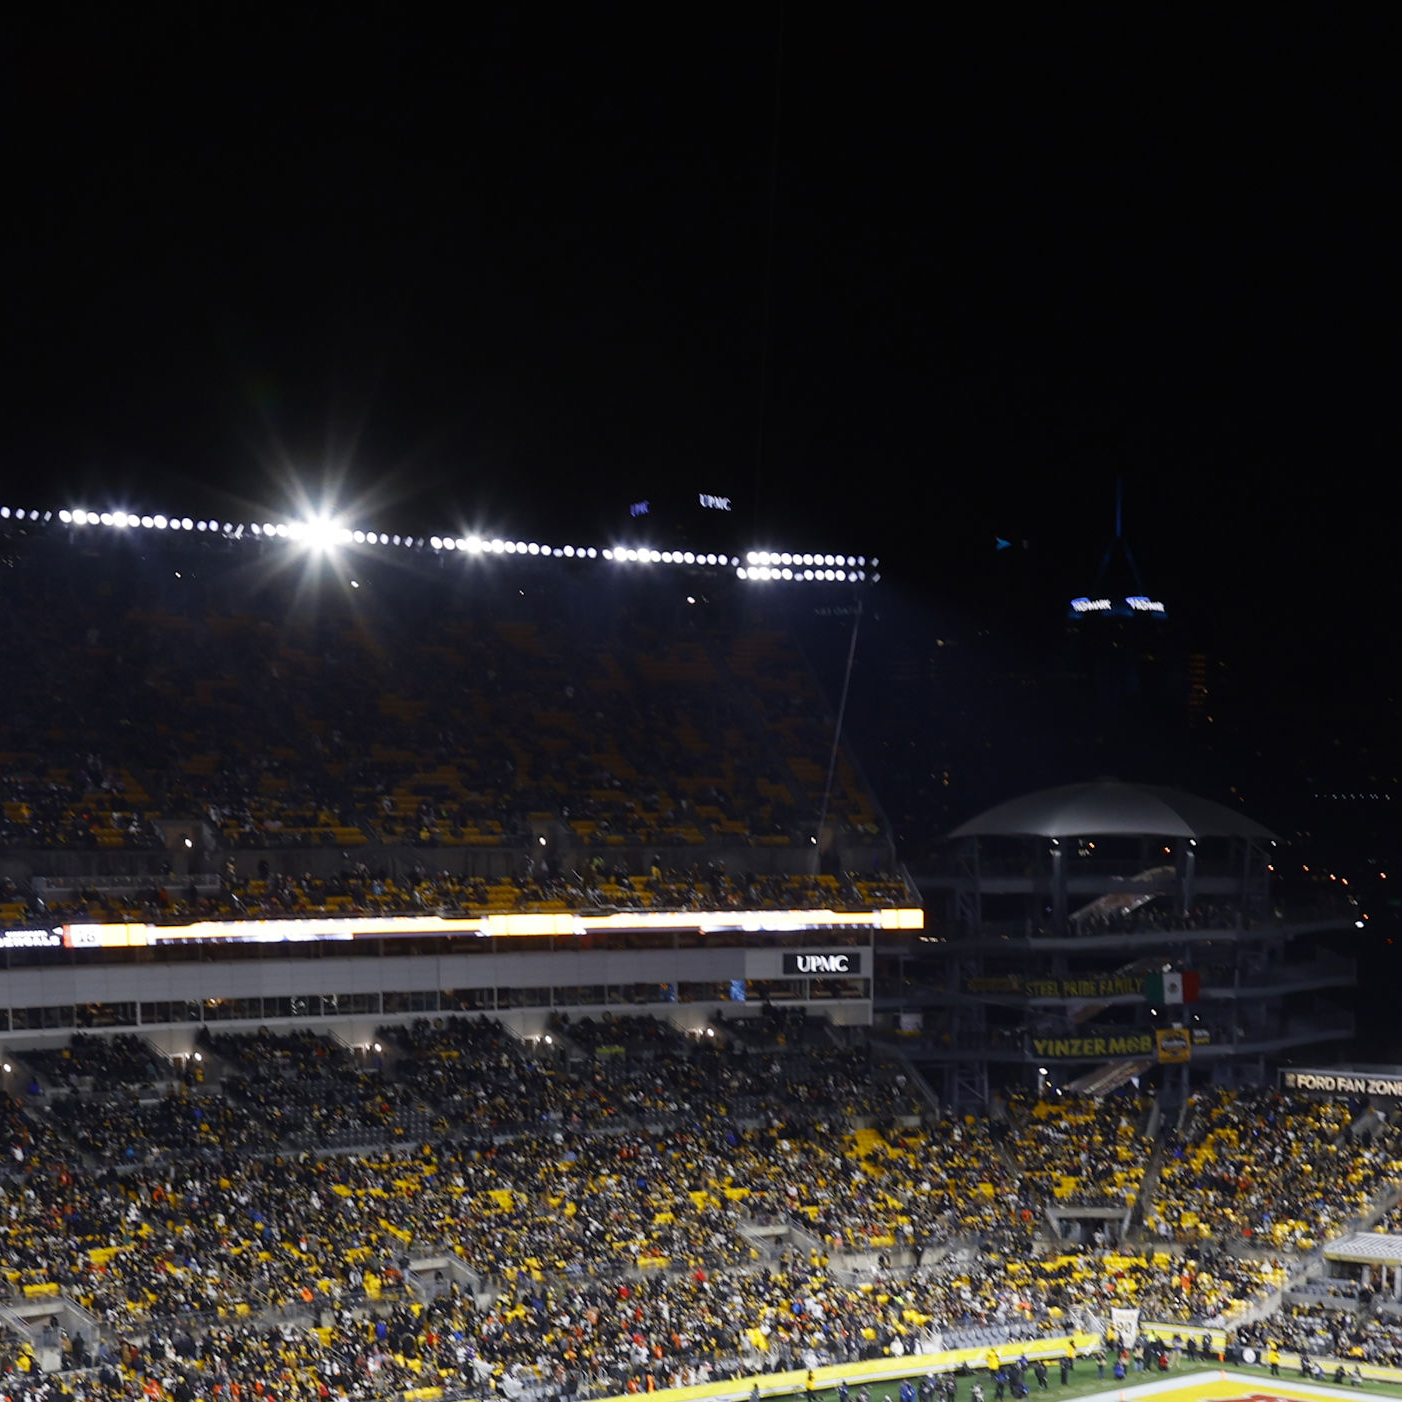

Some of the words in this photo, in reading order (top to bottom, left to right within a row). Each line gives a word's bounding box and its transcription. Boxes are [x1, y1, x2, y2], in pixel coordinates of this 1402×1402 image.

[699, 492, 732, 512] UPMC
[796, 954, 849, 973] UPMC
[1025, 981, 1060, 997] STEEL
[1064, 980, 1096, 997] PRIDE
[1100, 977, 1144, 996] FAMILY
[1297, 1073, 1336, 1092] FORD
[1337, 1077, 1366, 1094] FAN
